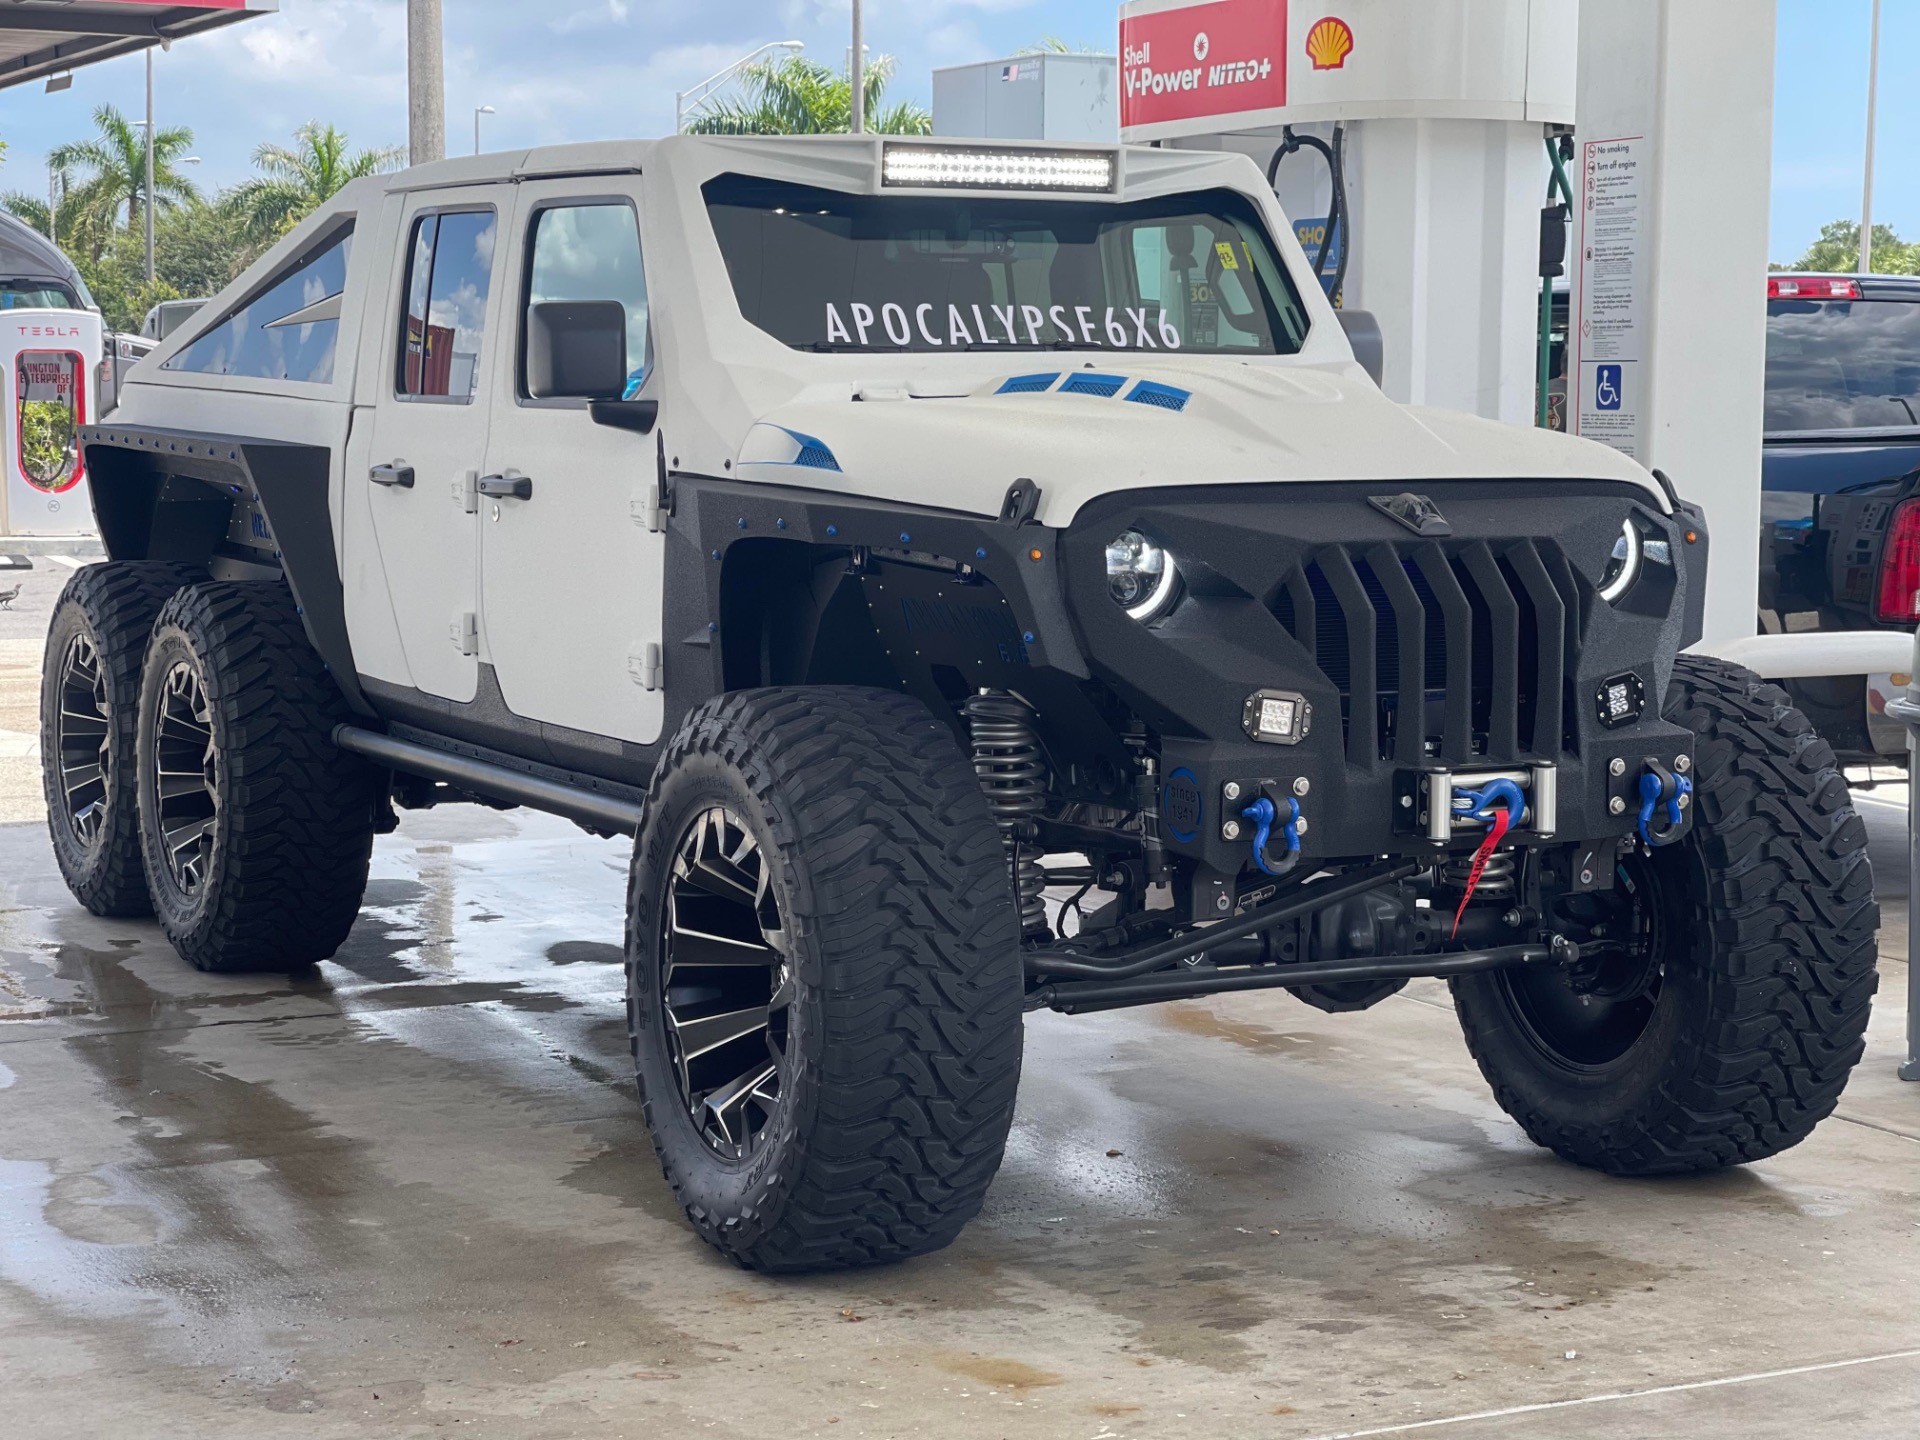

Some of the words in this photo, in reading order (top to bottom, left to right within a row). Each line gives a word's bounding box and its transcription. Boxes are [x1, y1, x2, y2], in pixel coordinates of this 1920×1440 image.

[1124, 41, 1150, 67] Shell
[1125, 67, 1202, 98] V-Power
[1597, 146, 1606, 155] No
[1607, 143, 1630, 154] smoking
[1597, 162, 1608, 171] Turn
[1609, 160, 1618, 170] off
[1618, 159, 1637, 171] engine
[1298, 226, 1326, 246] SHO
[17, 326, 79, 336] TESLA
[826, 302, 1180, 348] APOCALYPSE6X6
[20, 373, 71, 384] ETERPRISE
[1170, 784, 1197, 803] since
[1172, 805, 1194, 822] 1941
[637, 892, 650, 1030] TOYO
